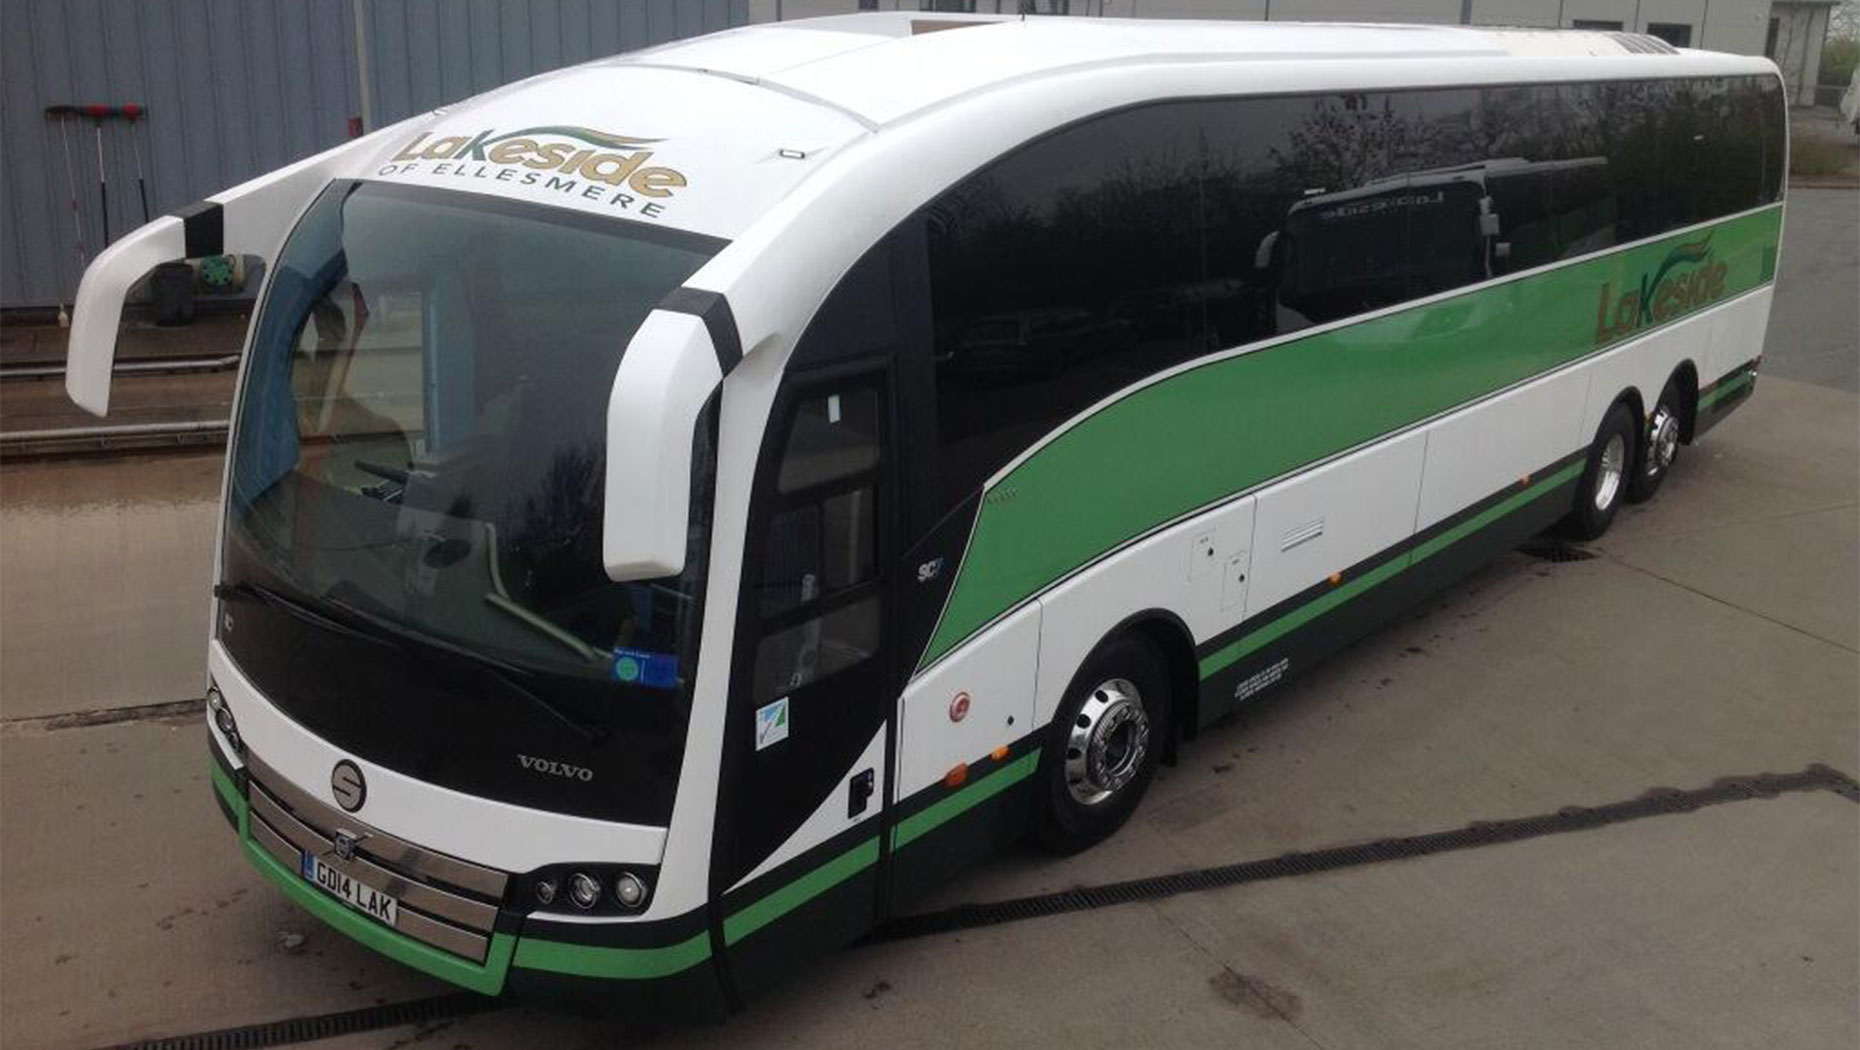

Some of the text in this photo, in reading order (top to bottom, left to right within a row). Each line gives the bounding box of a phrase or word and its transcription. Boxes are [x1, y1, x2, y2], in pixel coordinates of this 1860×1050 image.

[378, 163, 666, 218] OF ELLESMERE
[392, 126, 687, 198] Lakeside
[517, 753, 593, 781] VOLVO
[317, 861, 391, 921] GD14 LAK
